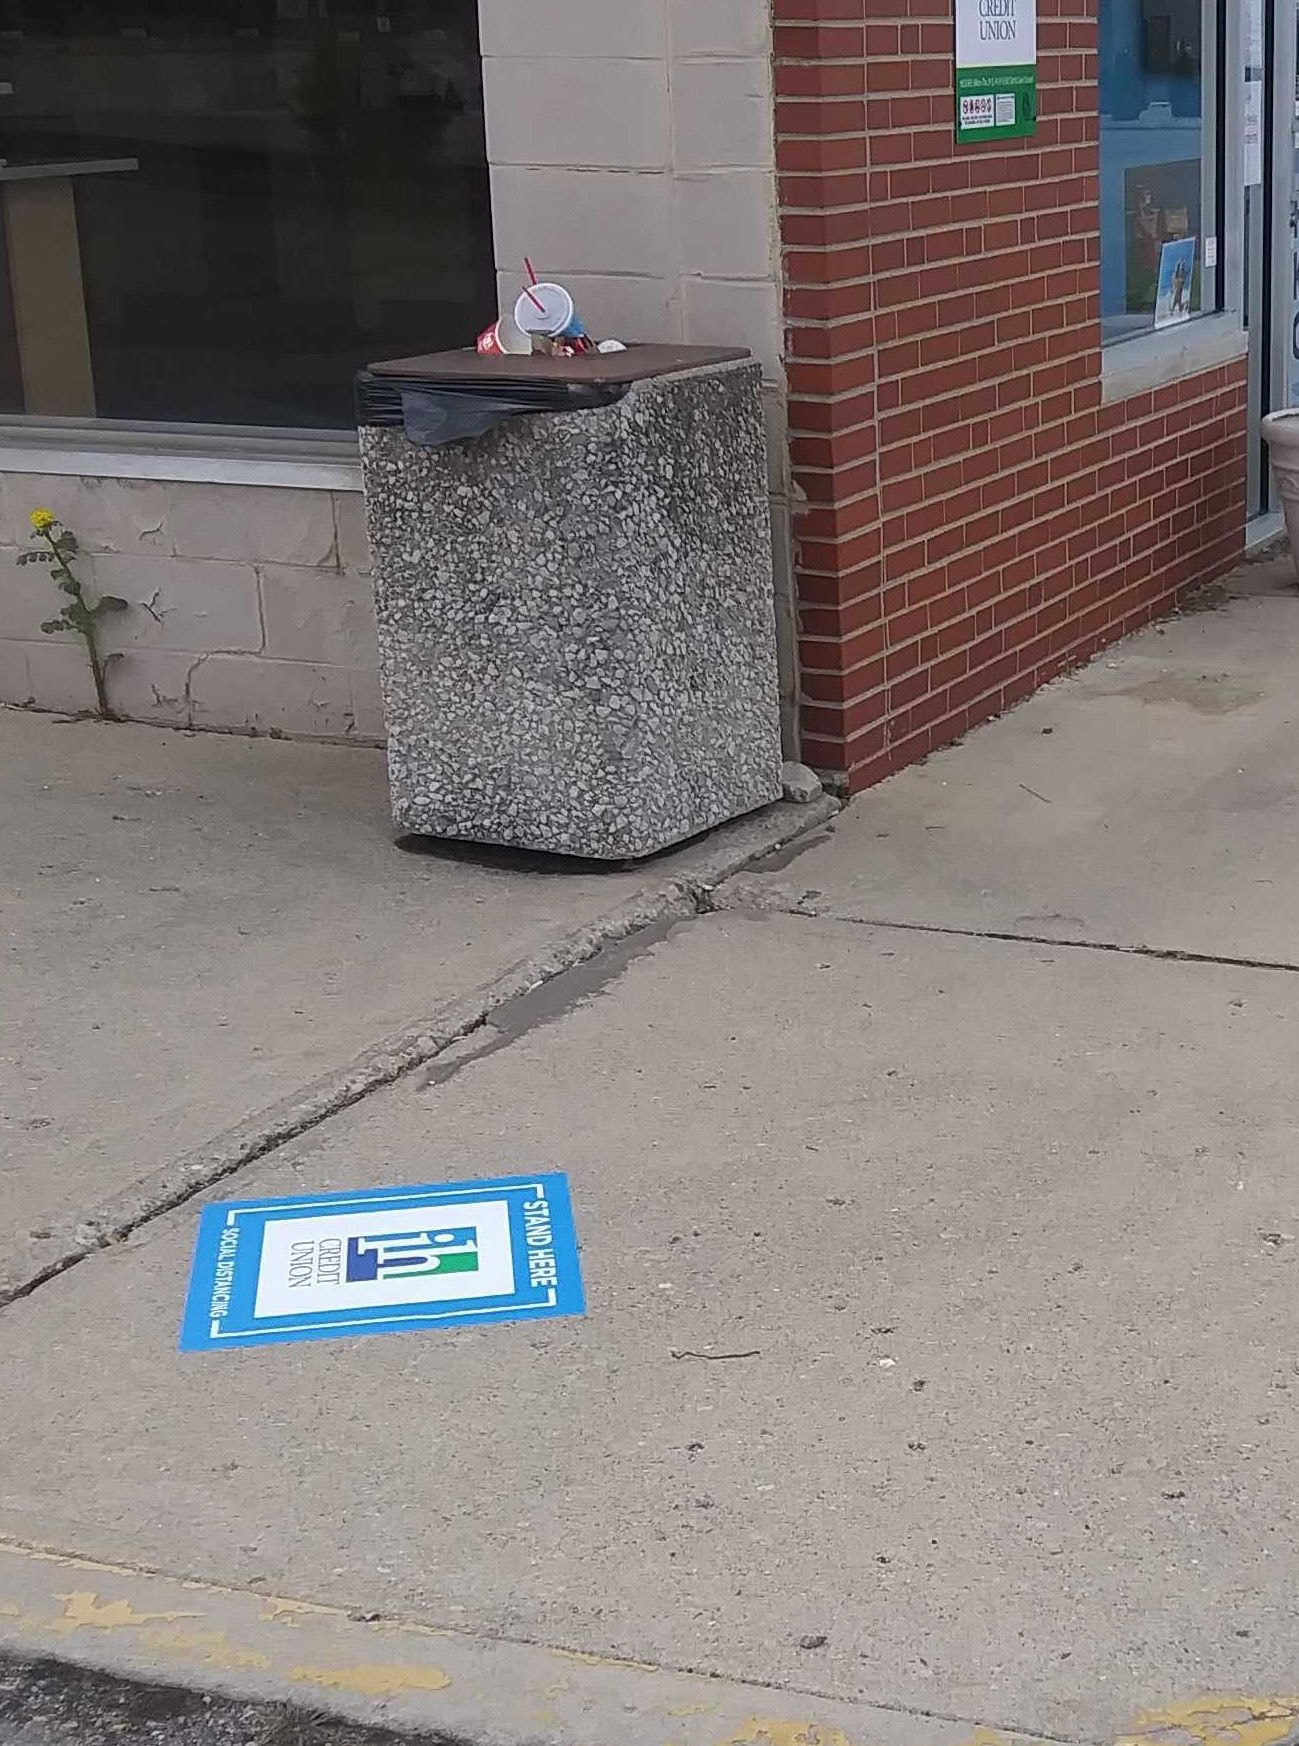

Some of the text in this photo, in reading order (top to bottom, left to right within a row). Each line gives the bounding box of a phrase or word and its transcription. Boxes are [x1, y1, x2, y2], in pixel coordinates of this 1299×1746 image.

[979, 0, 1016, 17] CREDIT
[980, 20, 1016, 40] UNION
[287, 1239, 315, 1289] UNION
[316, 1237, 342, 1285] CREDIT
[522, 1199, 558, 1288] STAND HERE
[209, 1227, 240, 1319] SOCIAL DISTANCING
